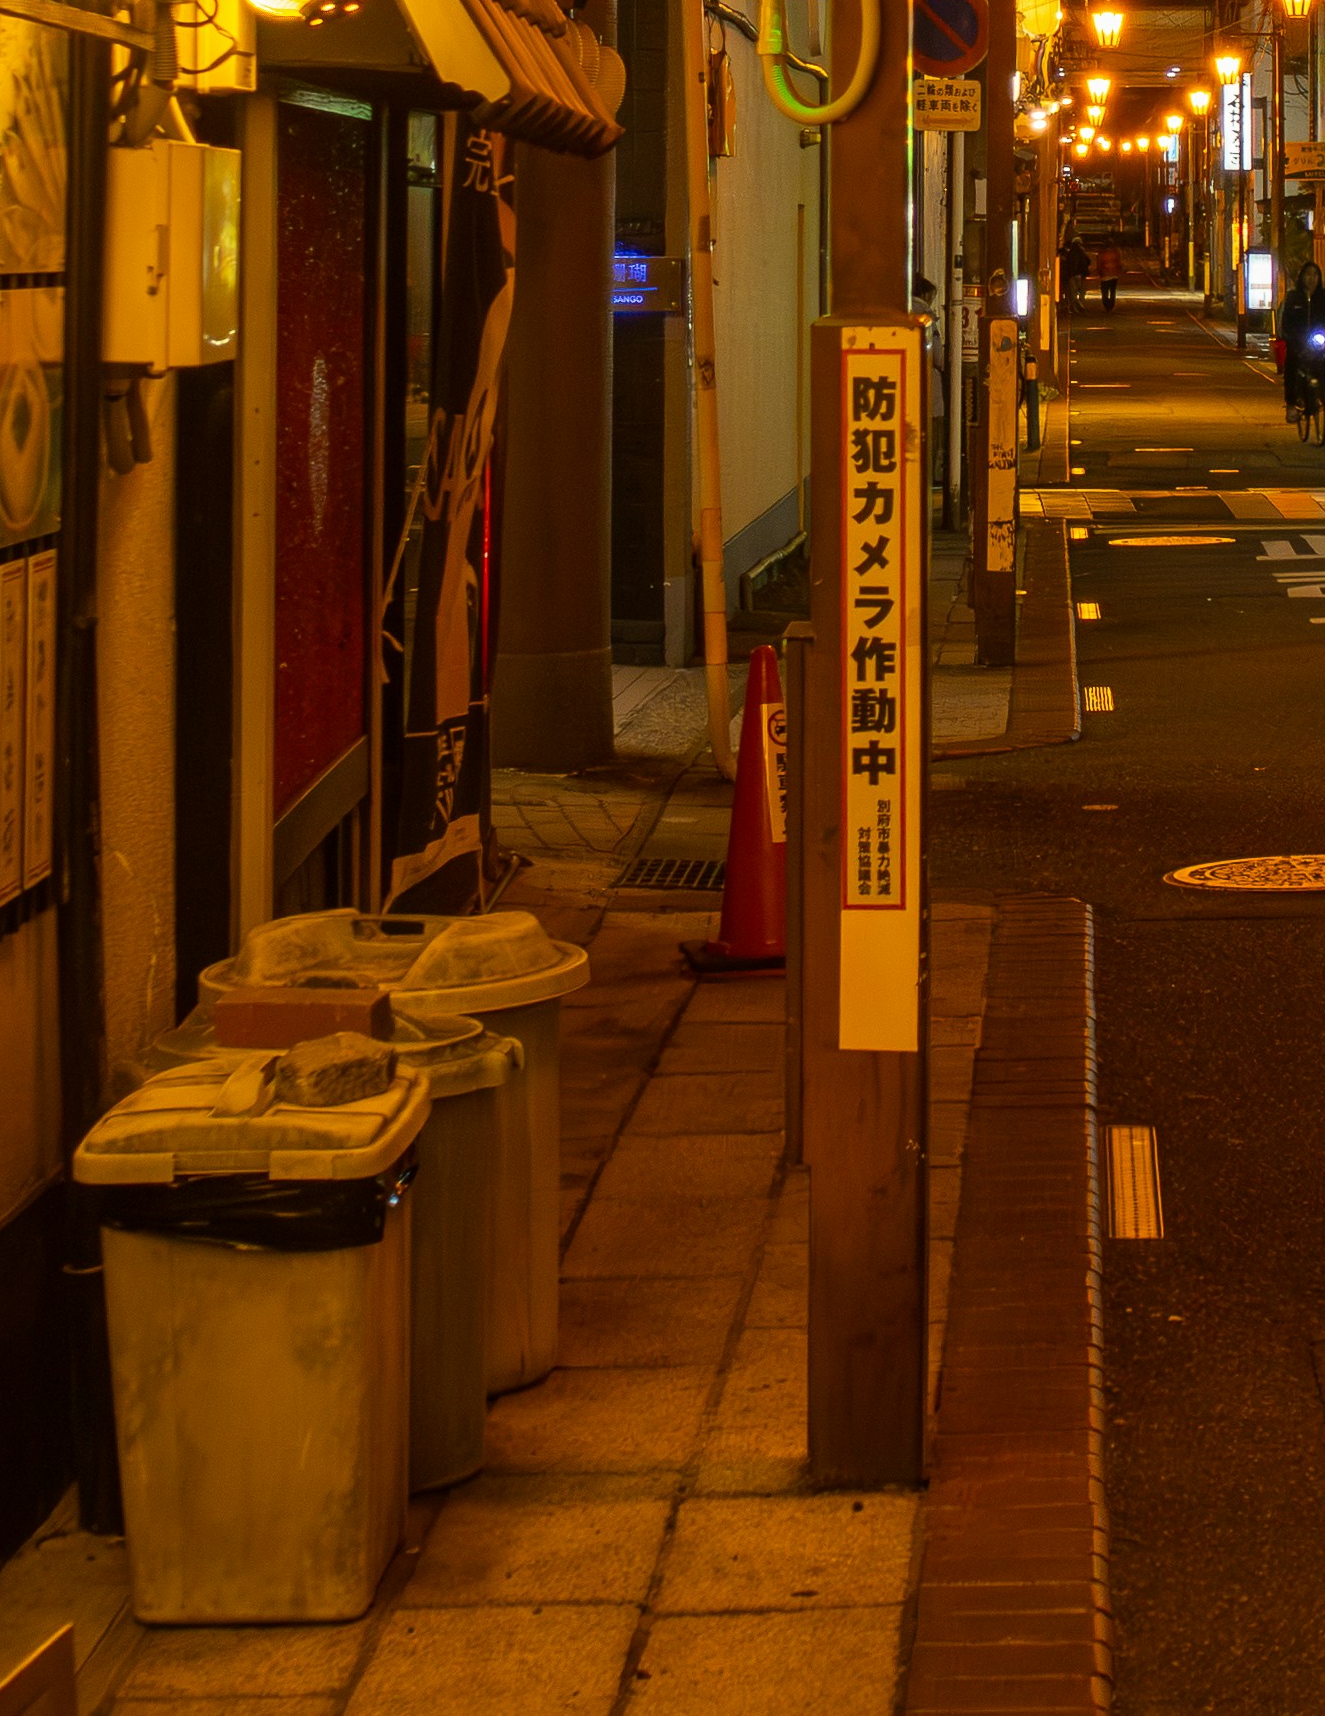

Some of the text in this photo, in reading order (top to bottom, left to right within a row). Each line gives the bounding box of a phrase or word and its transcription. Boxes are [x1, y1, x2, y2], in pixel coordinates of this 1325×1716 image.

[851, 376, 897, 785] 防犯カメラ作動中
